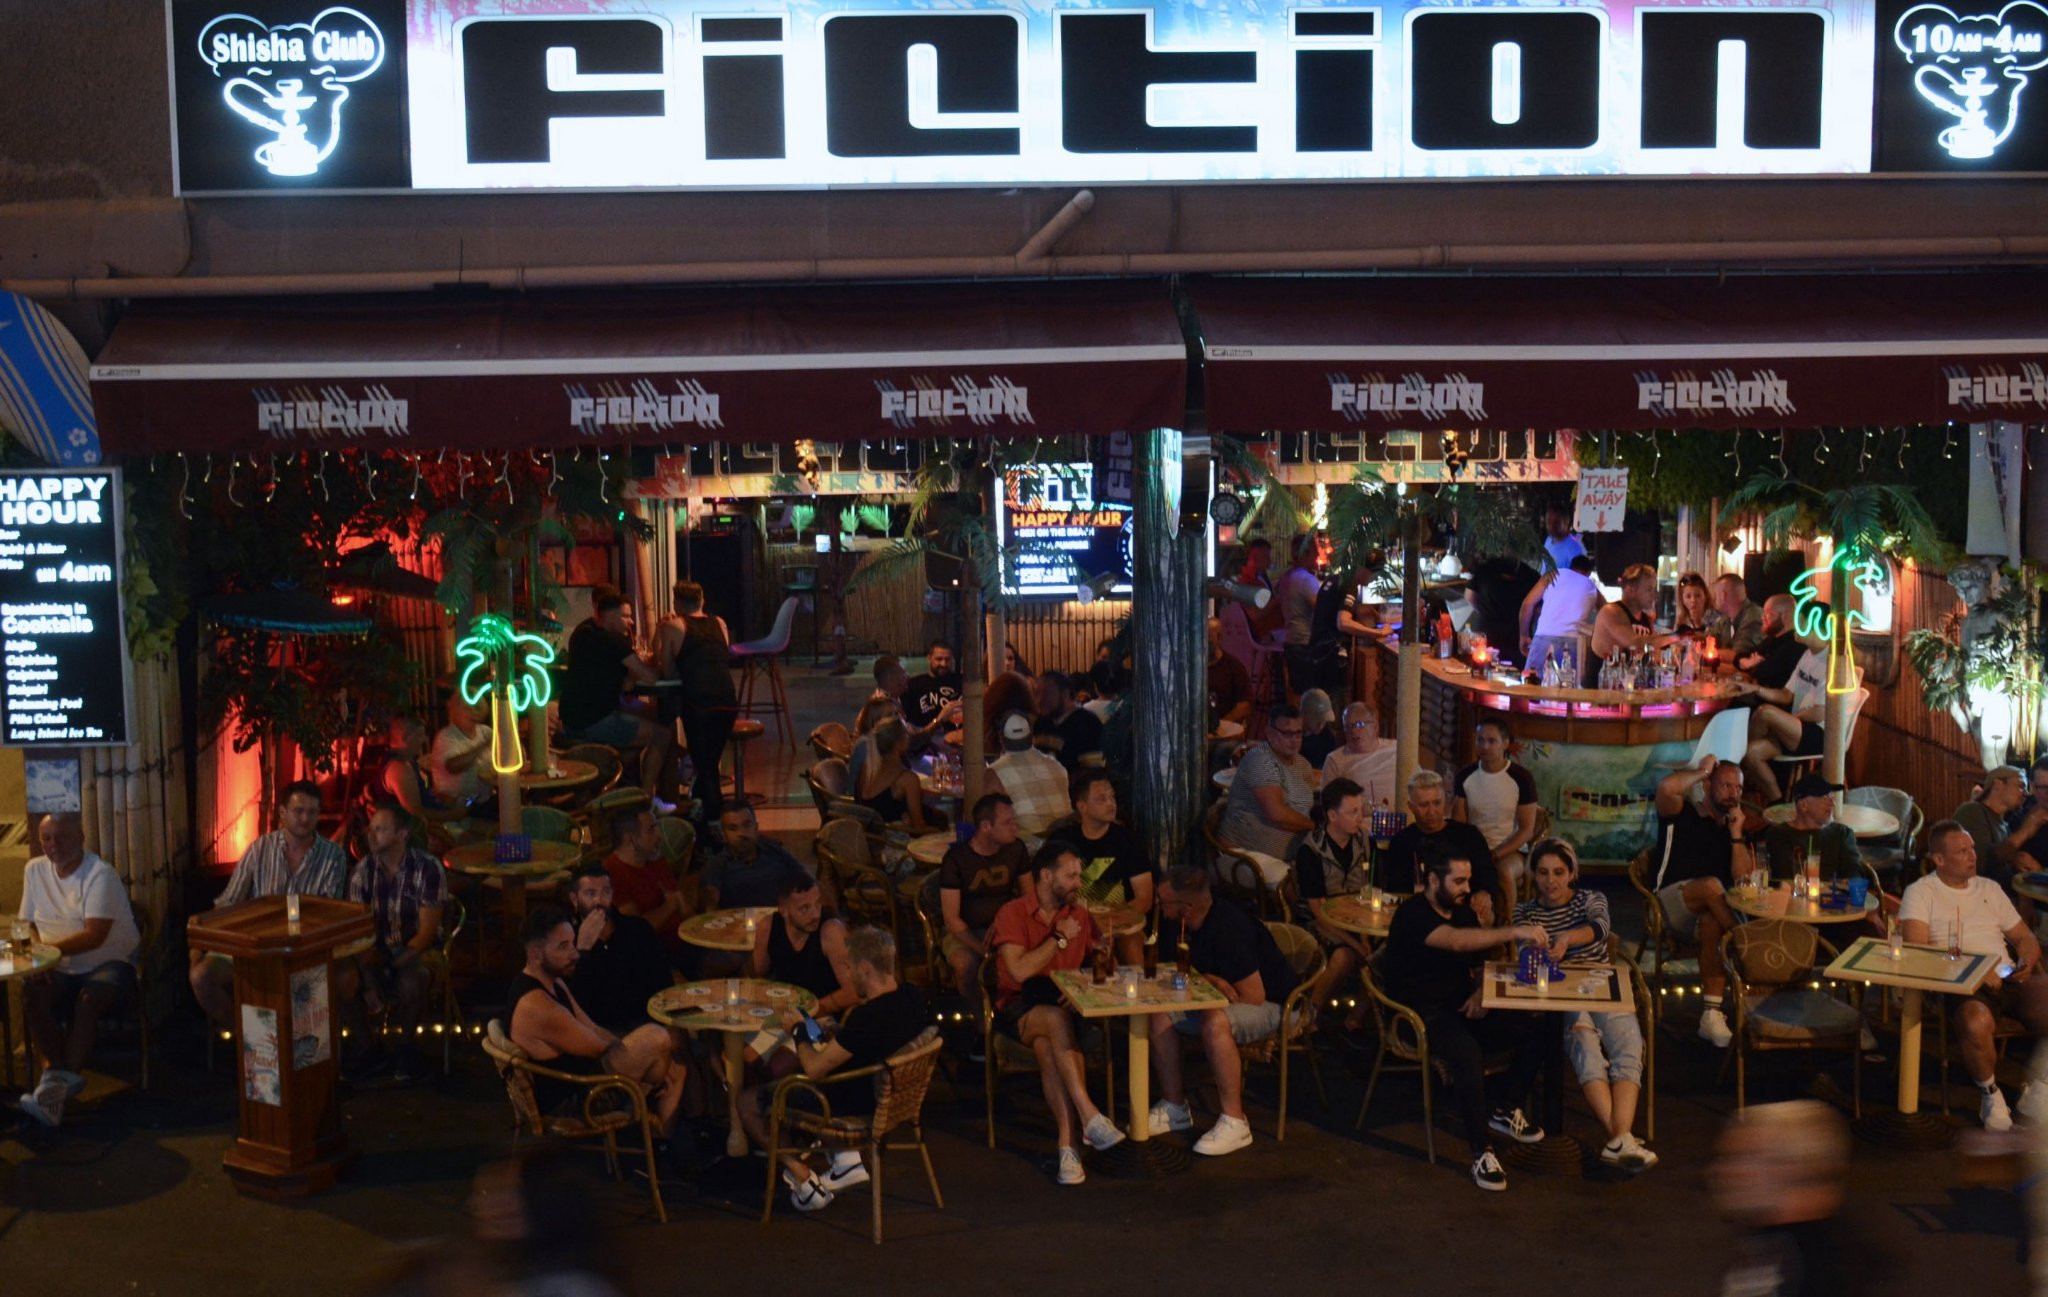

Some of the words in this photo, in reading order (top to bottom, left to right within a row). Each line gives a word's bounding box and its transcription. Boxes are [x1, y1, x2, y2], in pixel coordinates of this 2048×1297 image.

[213, 32, 306, 63] Shisha
[312, 30, 374, 62] Club
[1945, 371, 2047, 408] Ficti
[0, 477, 107, 500] HAPPY
[1584, 474, 1626, 489] TAKE
[1583, 493, 1624, 506] AWAY
[2, 500, 102, 525] HOUR
[1012, 512, 1067, 528] HAPPY
[59, 561, 111, 582] 4am
[2, 615, 94, 634] Cocktails
[10, 728, 36, 741] Long
